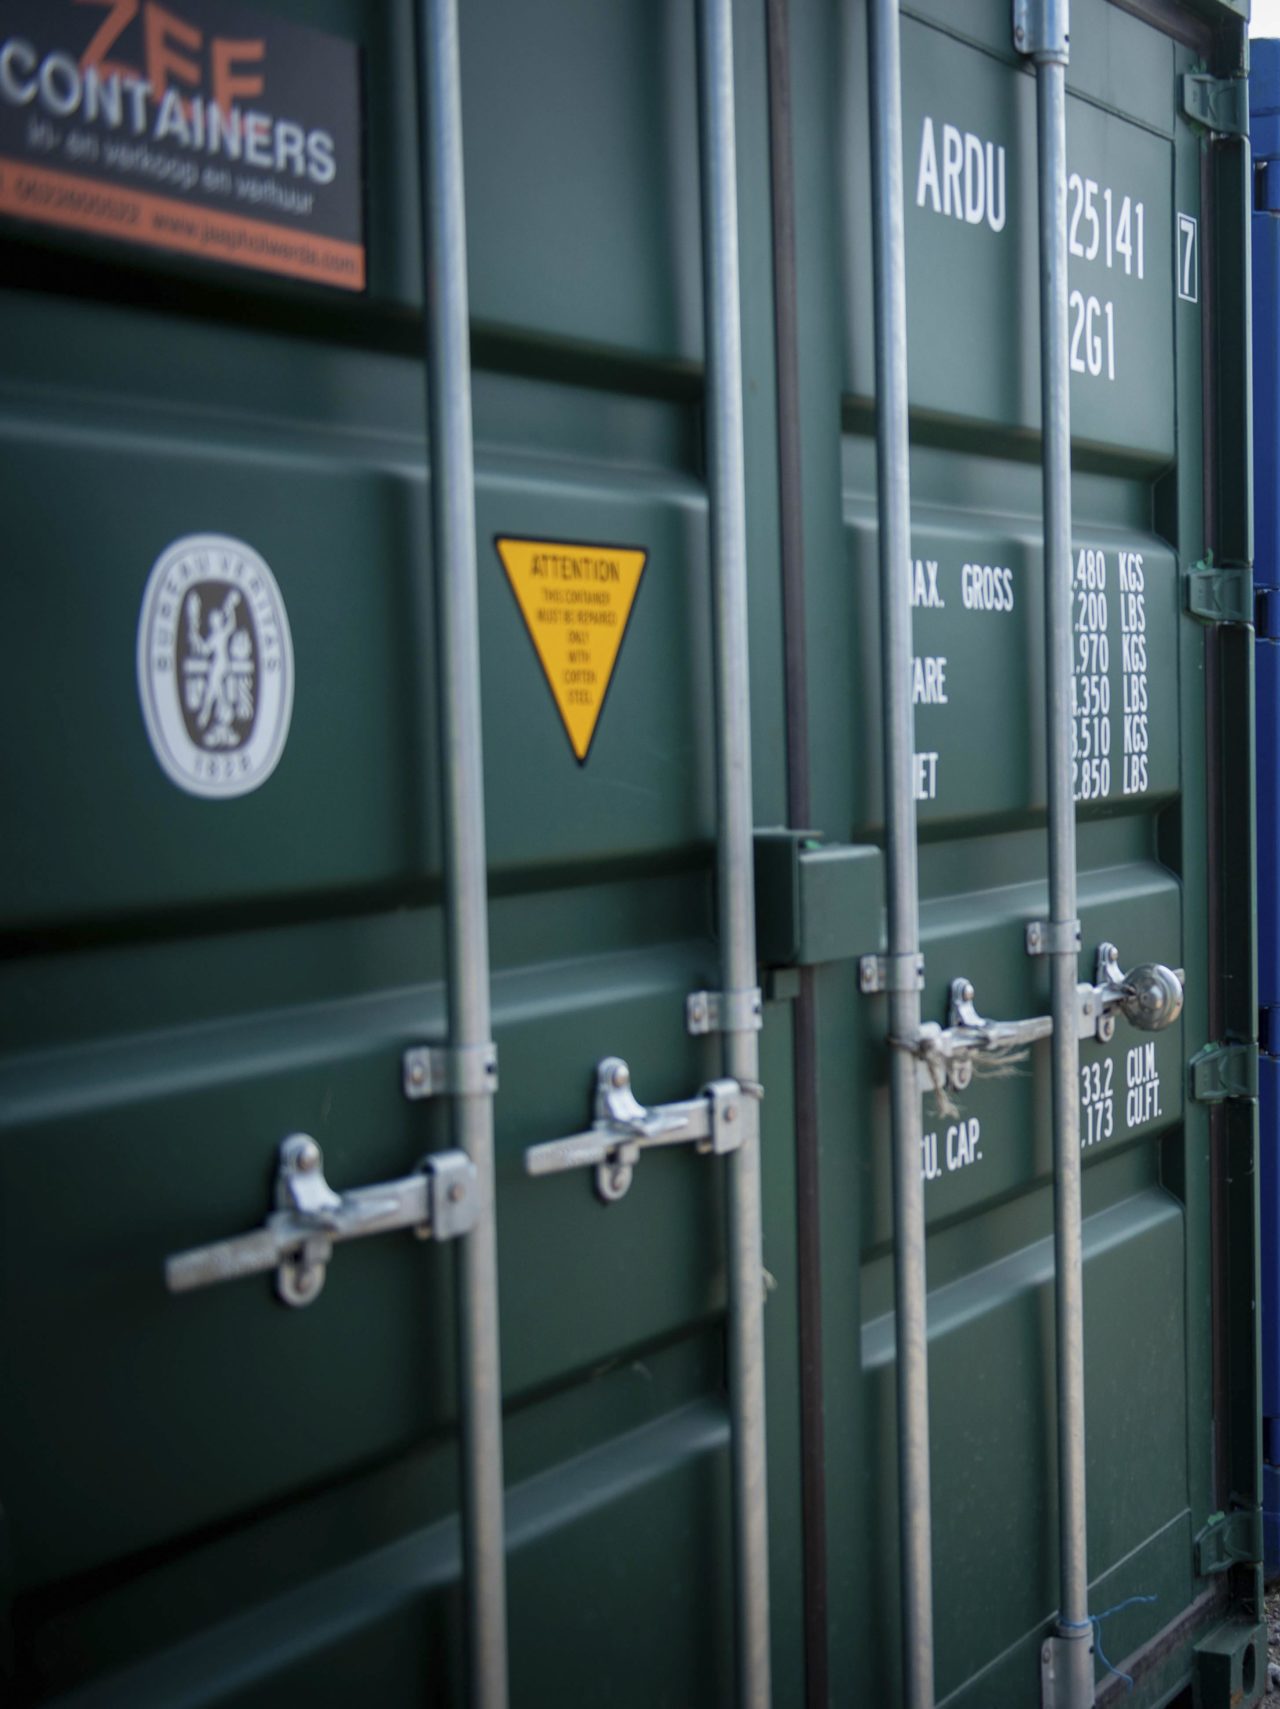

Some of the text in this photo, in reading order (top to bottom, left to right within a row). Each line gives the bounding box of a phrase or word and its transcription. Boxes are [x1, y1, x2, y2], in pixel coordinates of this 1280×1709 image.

[0, 38, 337, 185] CONTAINERS
[917, 116, 1006, 232] ARDU
[1063, 173, 1144, 279] 25141
[530, 553, 620, 583] ATTENTION
[961, 564, 1014, 612] GROSS
[1118, 551, 1145, 592] KGS
[1120, 593, 1146, 632] LBS
[1121, 633, 1146, 673] KGS
[911, 656, 948, 704] ARE
[1122, 674, 1148, 714] LBS
[1123, 715, 1149, 755] KGS
[1122, 754, 1149, 794] LBS
[1082, 1042, 1158, 1107] 33.2 CU.M.
[1126, 1079, 1162, 1128] CU.FT.
[946, 1117, 983, 1172] CAP.
